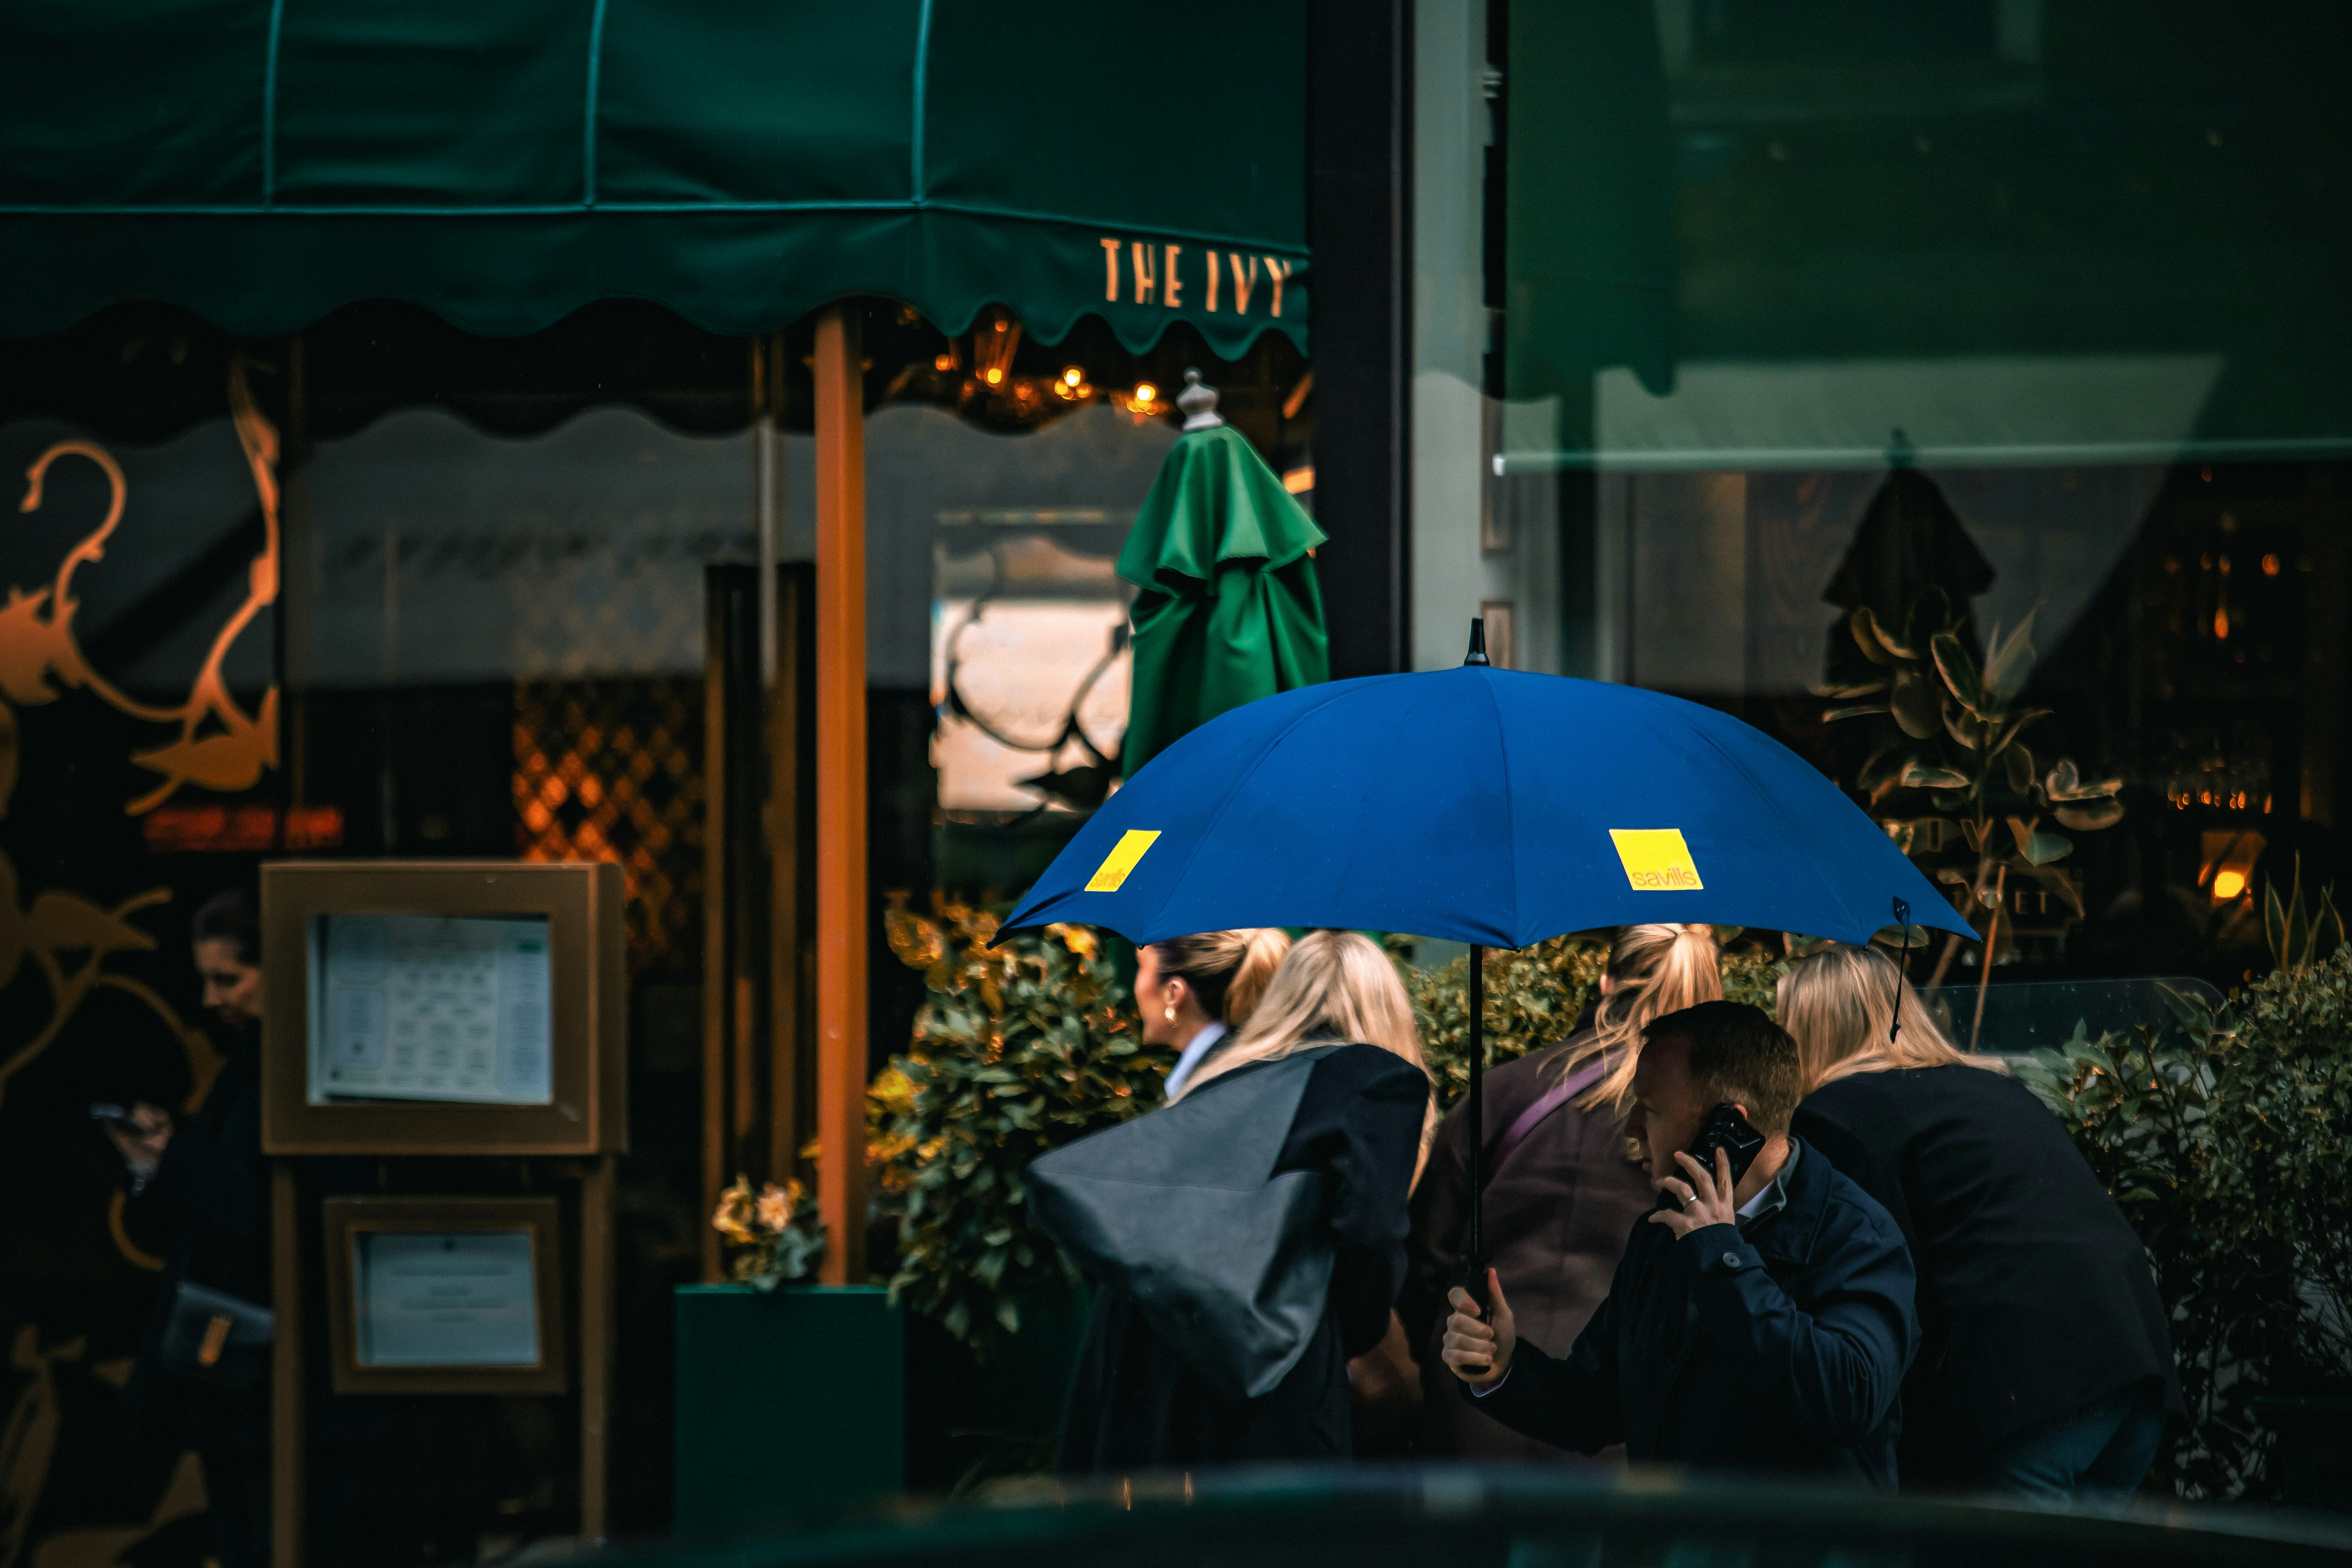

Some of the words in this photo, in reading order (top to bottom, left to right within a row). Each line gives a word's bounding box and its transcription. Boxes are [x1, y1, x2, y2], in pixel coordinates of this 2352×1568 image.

[1100, 238, 1183, 308] THE
[1205, 250, 1292, 318] IVY
[1632, 867, 1697, 887] savills
